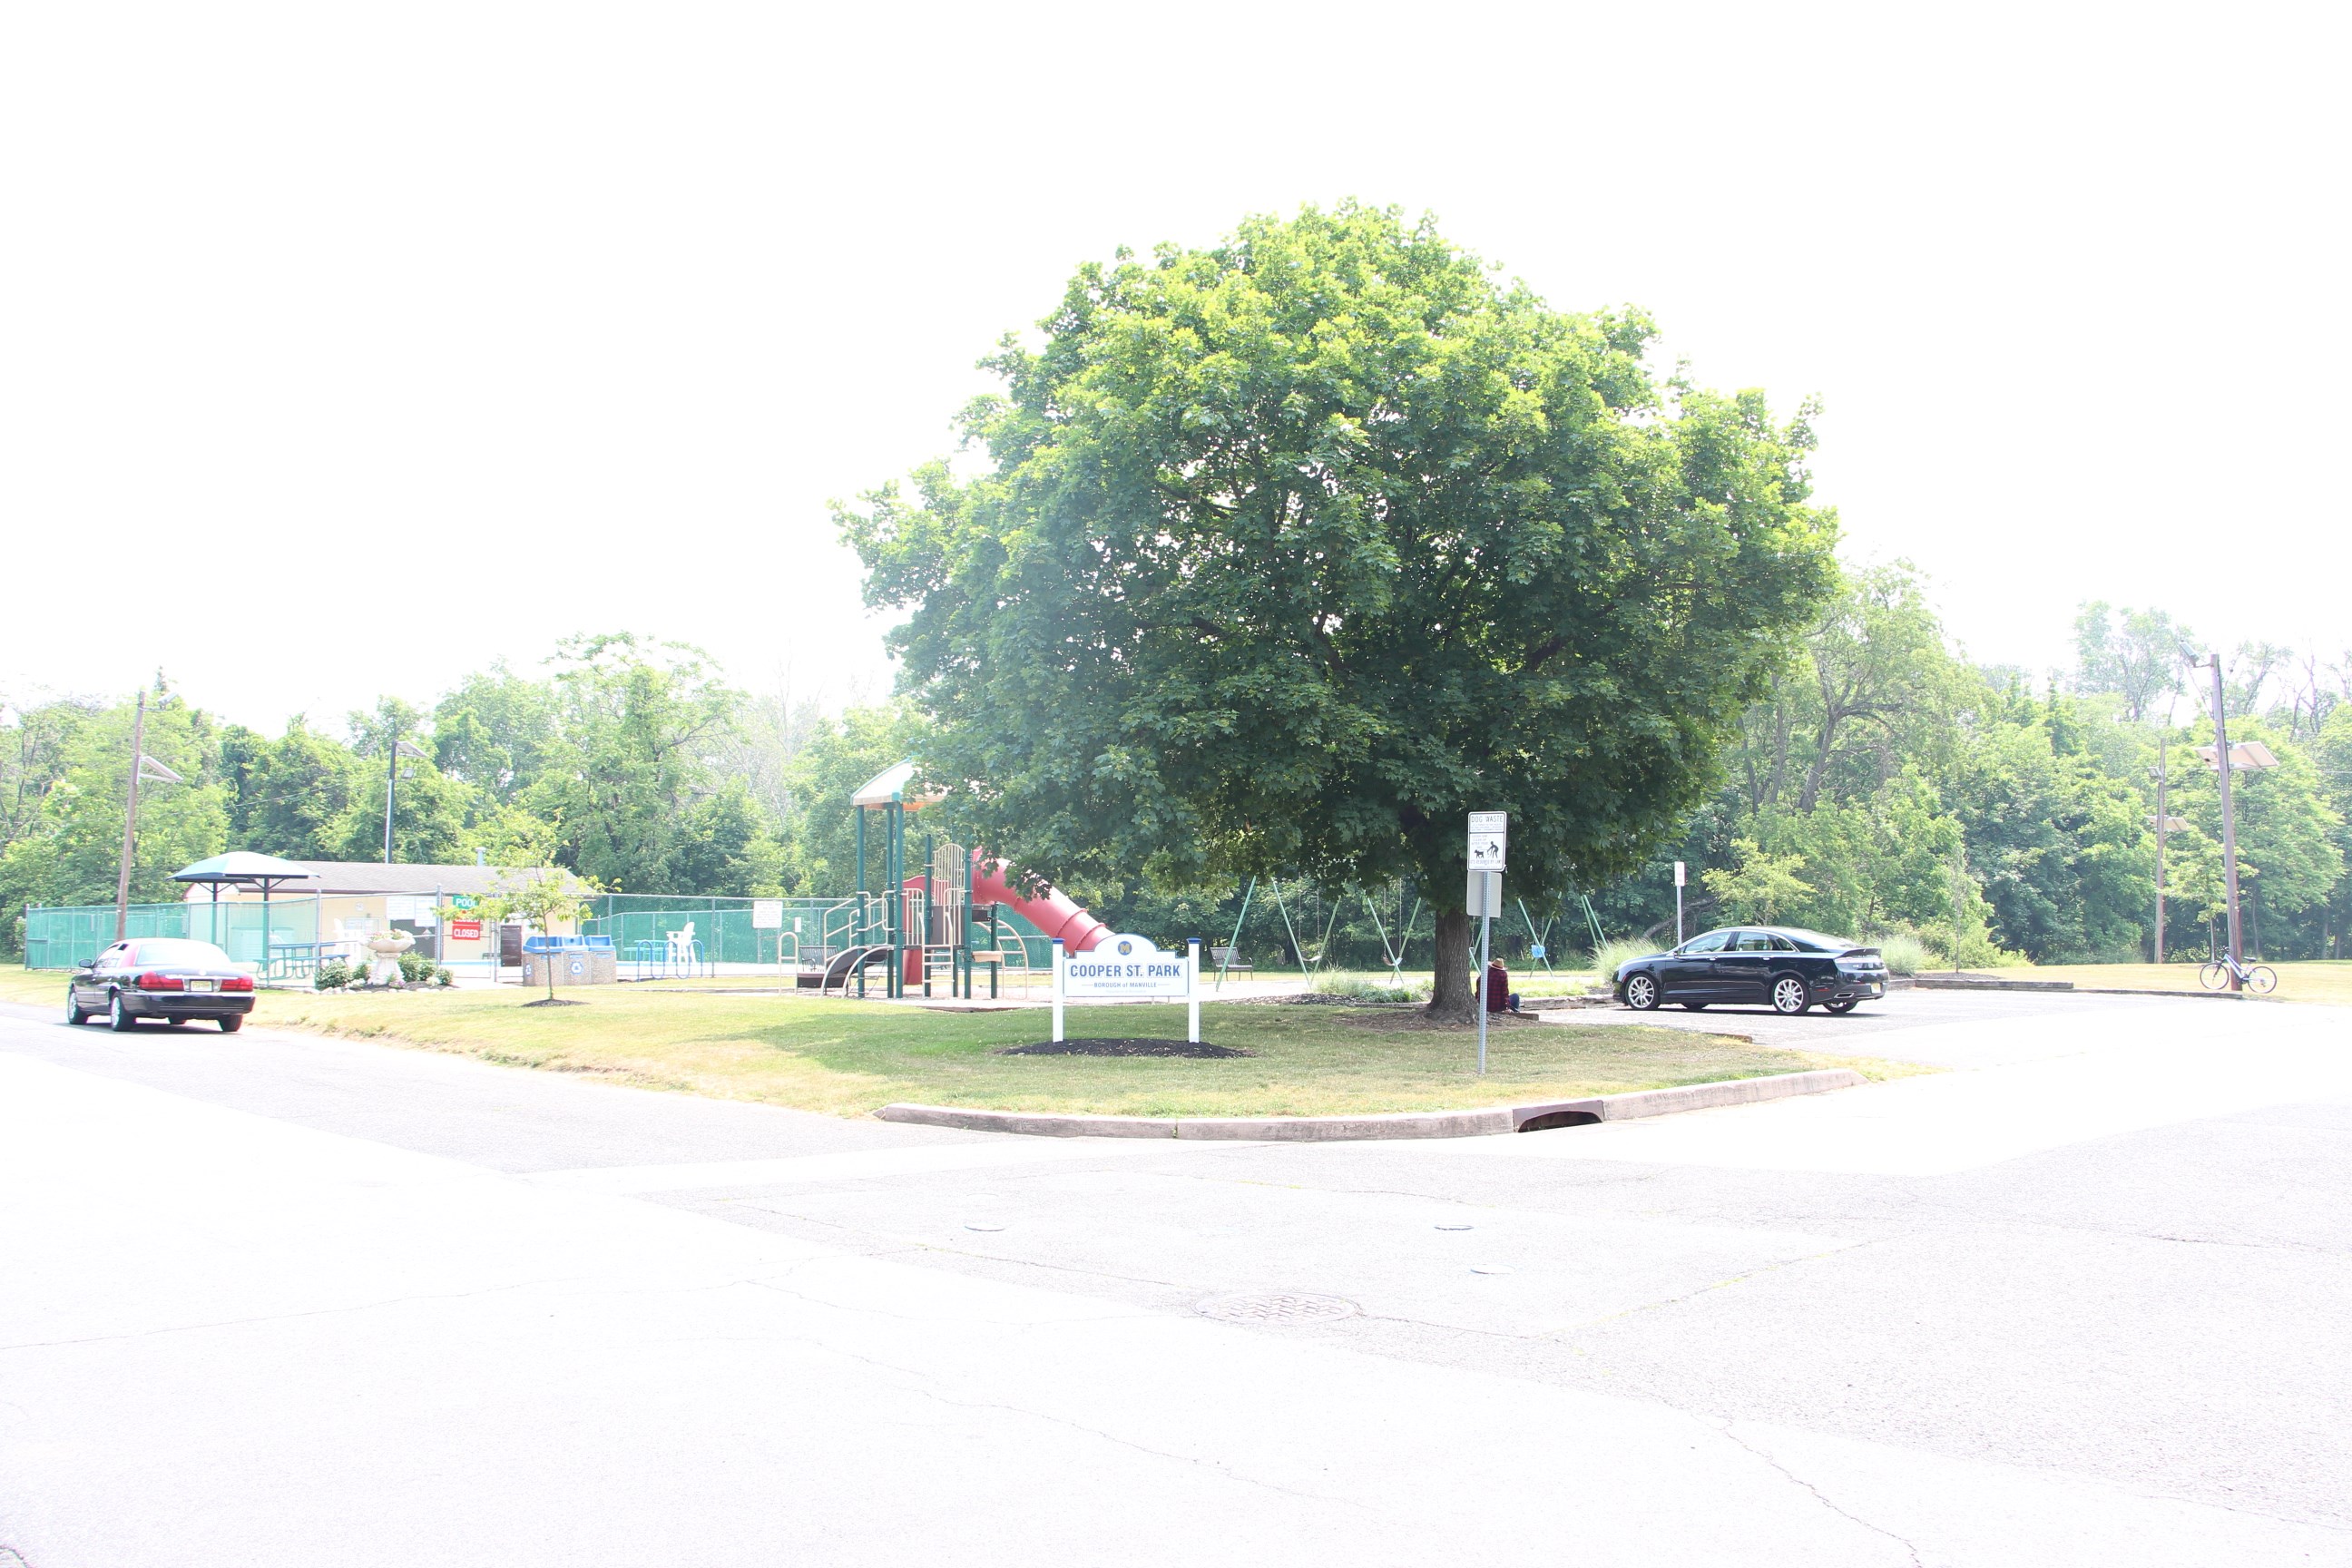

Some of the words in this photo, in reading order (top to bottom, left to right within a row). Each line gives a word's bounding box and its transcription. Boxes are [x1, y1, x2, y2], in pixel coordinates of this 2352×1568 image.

[454, 928, 479, 938] CLOSED
[1120, 944, 1130, 953] M
[1070, 965, 1122, 977] COOPER
[1126, 965, 1143, 977] ST.
[1148, 965, 1181, 977] PARK
